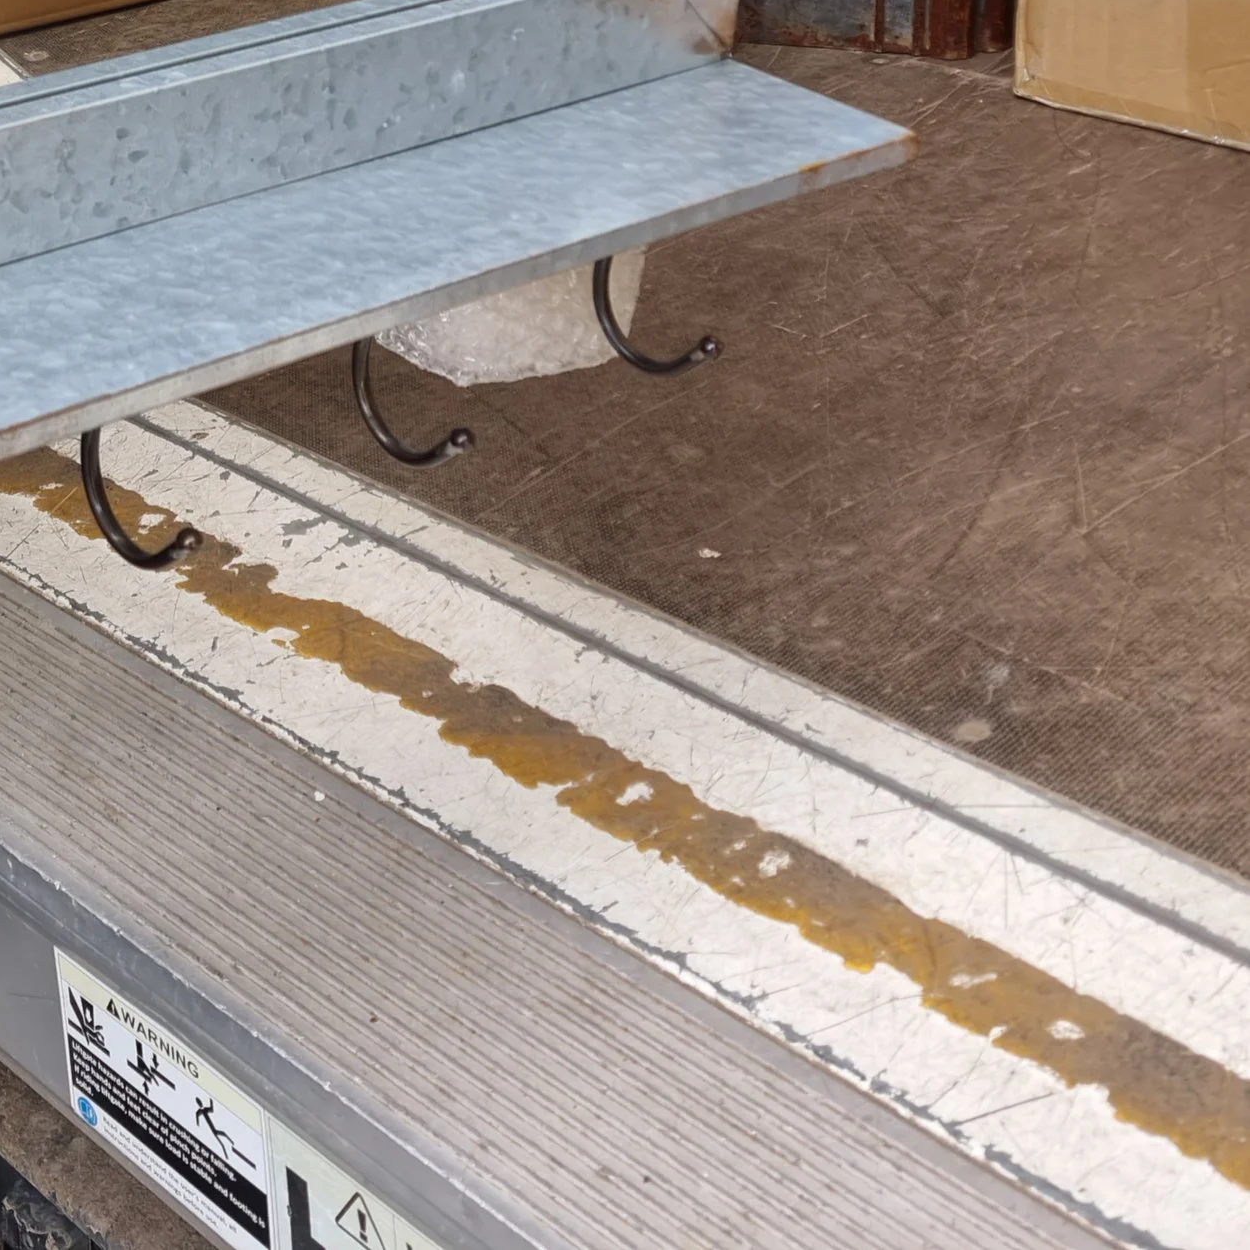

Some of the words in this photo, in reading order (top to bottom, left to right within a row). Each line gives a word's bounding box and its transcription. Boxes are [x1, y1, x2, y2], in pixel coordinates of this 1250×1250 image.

[121, 1007, 199, 1079] WARNING
[72, 1051, 90, 1073] Keep
[90, 1065, 111, 1090] hands
[112, 1083, 126, 1102] and
[126, 1095, 141, 1115] feet
[141, 1108, 159, 1130] clear
[159, 1122, 169, 1138] of
[169, 1130, 190, 1157] pinch
[190, 1148, 216, 1179] points.
[74, 1062, 79, 1075] If
[80, 1067, 100, 1093] riding
[127, 1107, 147, 1132] make
[147, 1125, 164, 1146] sure
[164, 1137, 182, 1160] load
[181, 1152, 189, 1166] is
[188, 1158, 212, 1185] stable
[212, 1178, 228, 1199] and
[228, 1190, 257, 1225] footing
[257, 1214, 265, 1230] is
[97, 1060, 124, 1089] hazards
[124, 1083, 137, 1100] can
[138, 1094, 159, 1118] result
[159, 1111, 167, 1125] in
[167, 1118, 200, 1153] crushing
[200, 1146, 208, 1159] or
[210, 1152, 236, 1183] falling.
